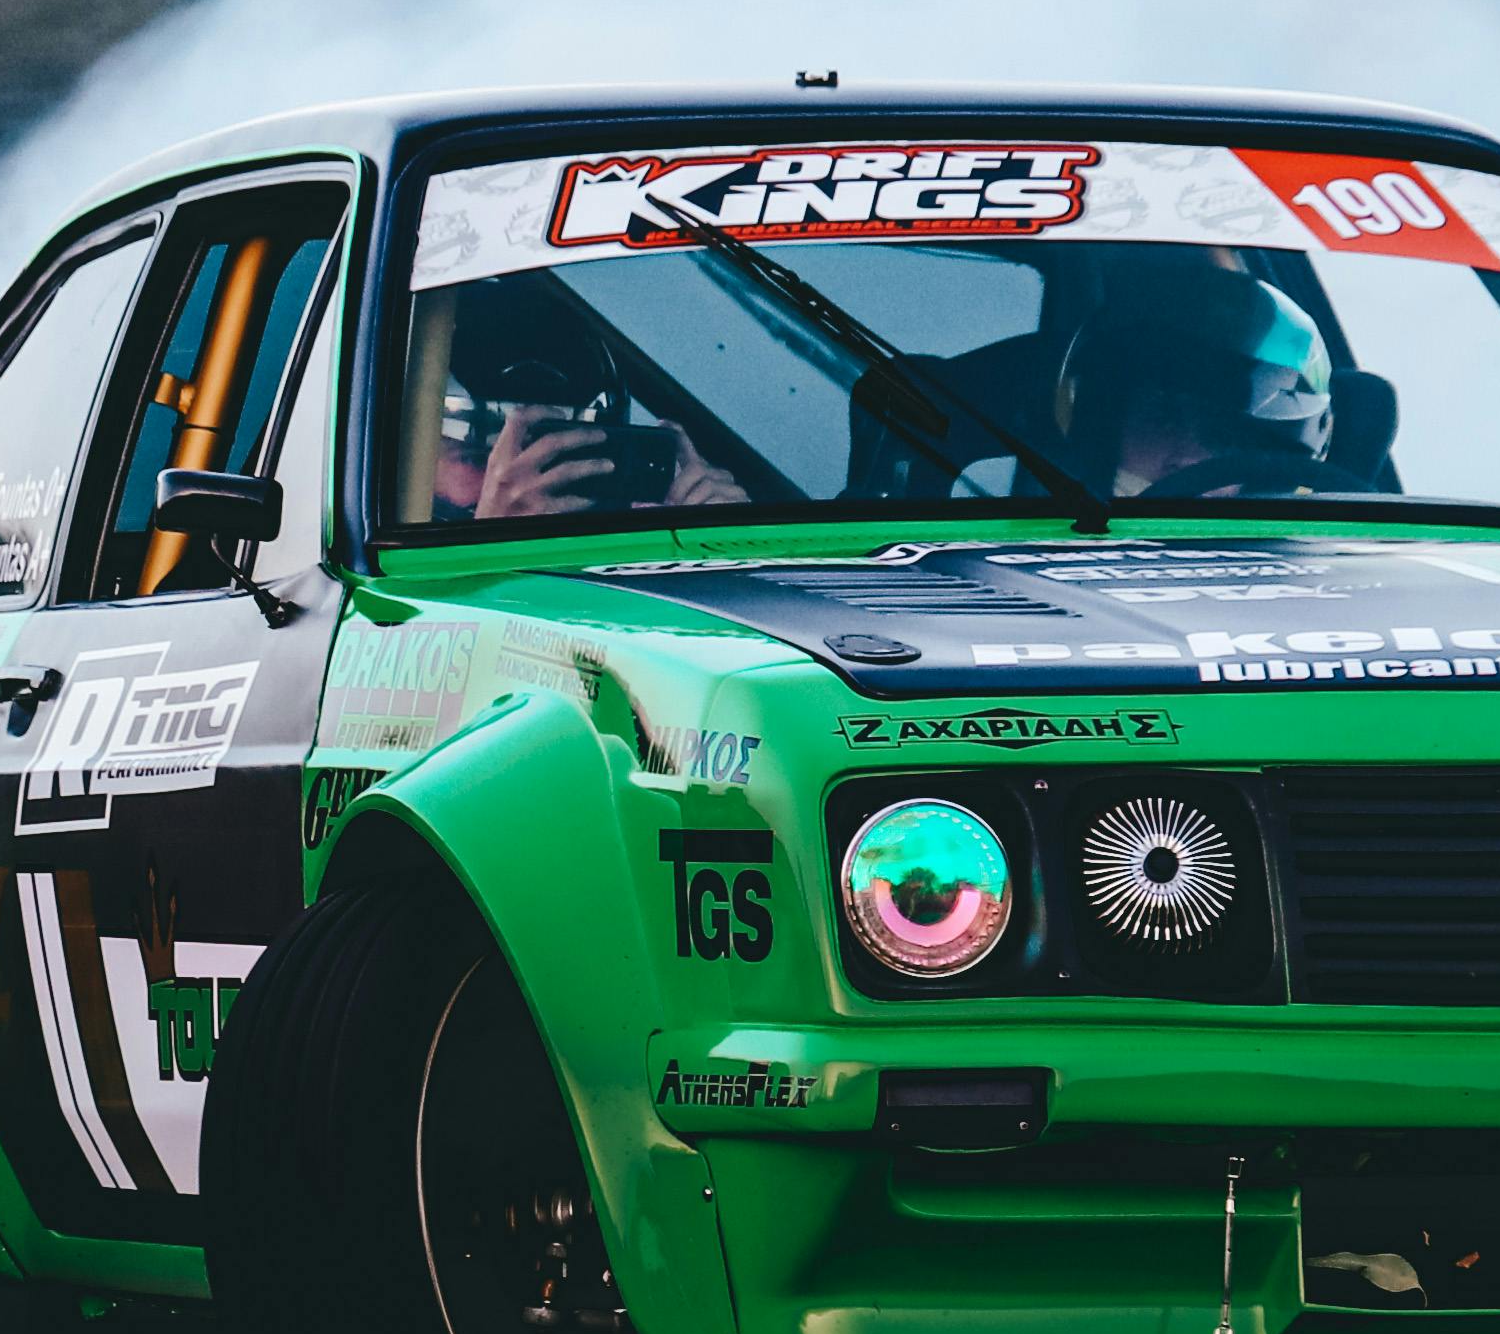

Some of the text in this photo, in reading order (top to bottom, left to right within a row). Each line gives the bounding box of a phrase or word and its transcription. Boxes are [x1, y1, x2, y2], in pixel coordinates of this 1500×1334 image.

[757, 150, 1089, 183] DRIFT
[1292, 172, 1447, 240] 190
[912, 219, 1017, 230] SERIES
[328, 629, 474, 693] DRAKOS
[849, 713, 1169, 743] ΖΑΧΑΡΙΑΔΗΣ
[96, 752, 220, 780] PERFORMANCE
[658, 828, 775, 962] TGS
